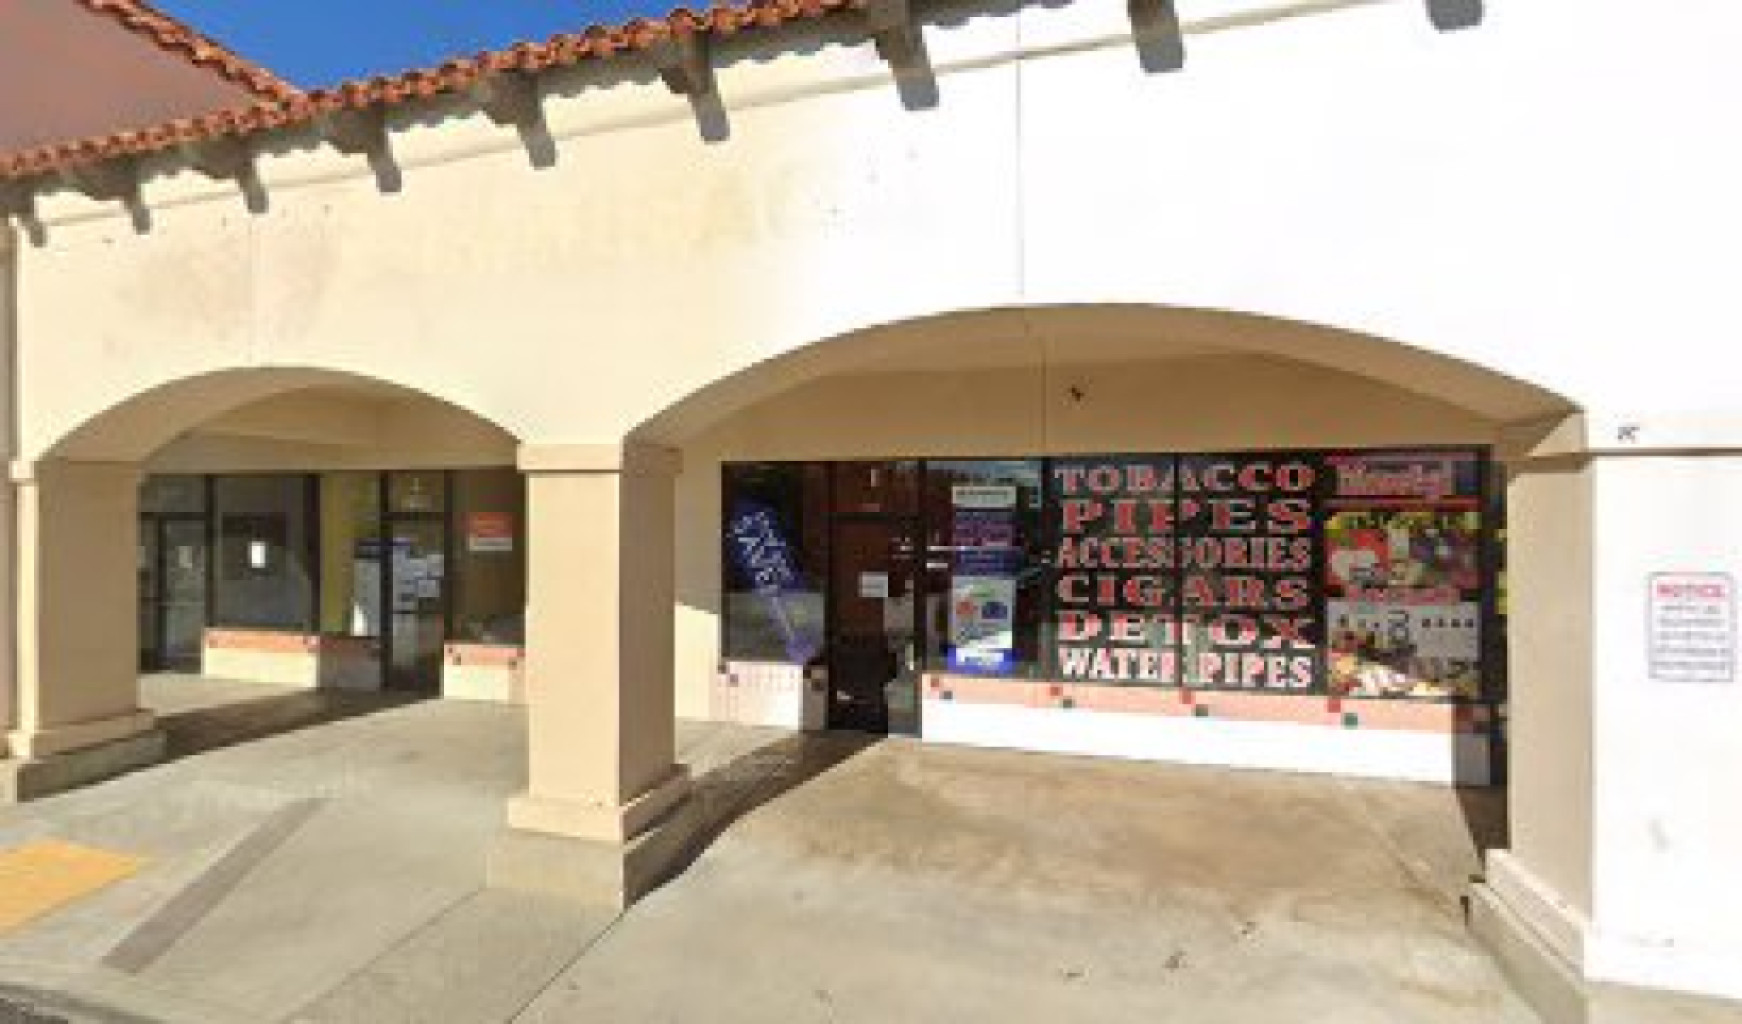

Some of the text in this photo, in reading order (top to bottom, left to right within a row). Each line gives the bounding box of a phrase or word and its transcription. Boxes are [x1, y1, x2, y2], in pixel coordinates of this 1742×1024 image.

[1054, 463, 1316, 493] TOBACCO
[1061, 499, 1311, 534] PIPES
[1055, 537, 1312, 569] ACCESSORIES
[1055, 574, 1311, 609] CIGARS
[1056, 611, 1316, 648] DETOX
[1200, 652, 1313, 688] PIPES
